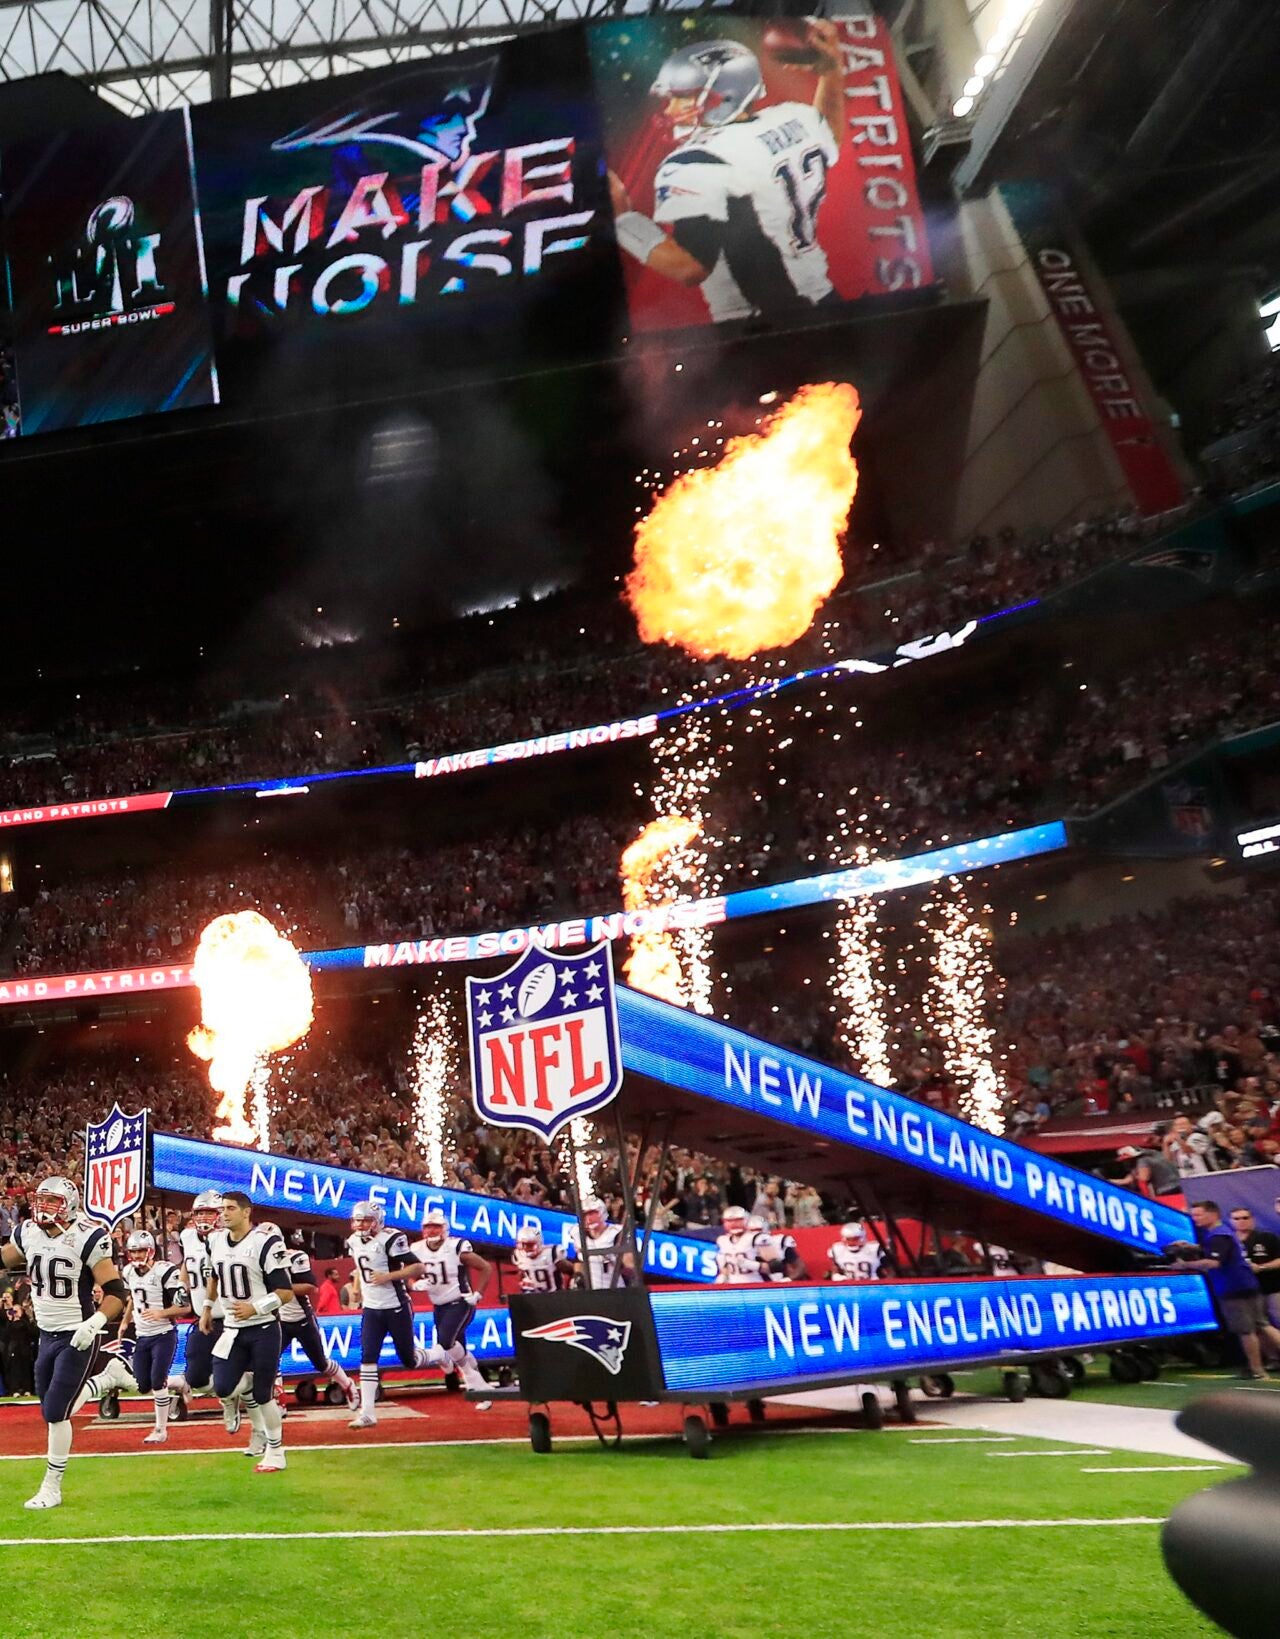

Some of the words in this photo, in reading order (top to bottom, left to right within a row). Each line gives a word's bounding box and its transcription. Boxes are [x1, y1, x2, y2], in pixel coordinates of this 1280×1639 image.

[831, 14, 922, 291] PATRIOTS
[240, 136, 577, 267] MAKE
[1038, 248, 1095, 316] ONE
[61, 315, 113, 336] SUPER
[117, 307, 161, 325] BOWL
[414, 751, 488, 779] MAKE
[491, 735, 568, 762] SOME
[569, 713, 658, 749] NOISE
[50, 799, 129, 817] PATRIOTS
[364, 936, 471, 967] MAKE
[477, 918, 586, 956] SOME
[591, 895, 726, 943] NOISE
[486, 1018, 604, 1112] NFL
[723, 1042, 822, 1119] NEW
[845, 1089, 1014, 1190] ENGLAND
[1025, 1162, 1158, 1244] PATRIOTS
[90, 1156, 137, 1212] NFL
[250, 1163, 346, 1208] NEW
[29, 1253, 75, 1299] 46
[216, 1262, 252, 1300] 10
[358, 1256, 374, 1284] 6
[764, 1302, 860, 1360] NEW
[882, 1292, 1042, 1351] ENGLAND
[1051, 1287, 1177, 1332] PATRIOTS
